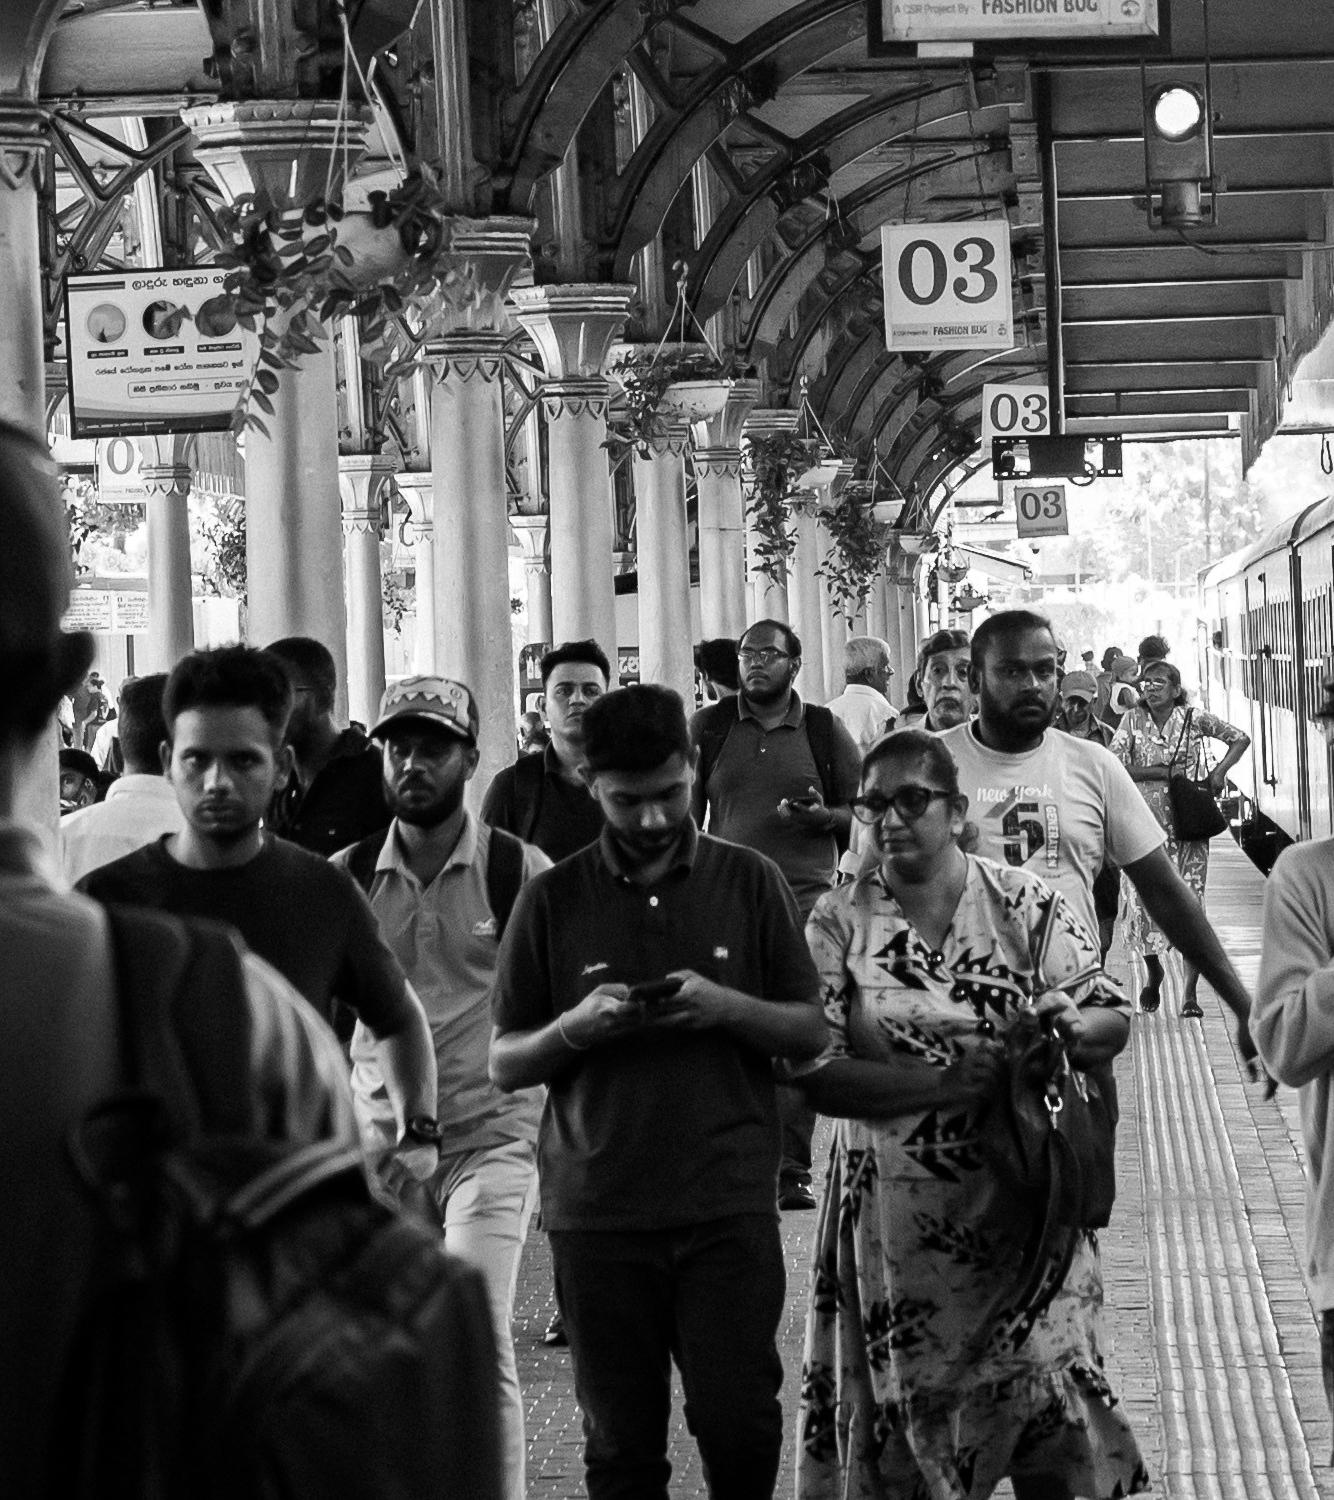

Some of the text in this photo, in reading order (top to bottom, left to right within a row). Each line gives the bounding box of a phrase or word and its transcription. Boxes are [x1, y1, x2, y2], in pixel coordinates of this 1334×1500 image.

[898, 236, 998, 305] 03
[933, 326, 969, 336] FASHION
[971, 325, 988, 335] BUG
[990, 393, 1048, 432] 03
[107, 436, 144, 474] 0
[1020, 490, 1062, 520] 03
[977, 787, 1009, 802] new
[1002, 802, 1045, 867] 5
